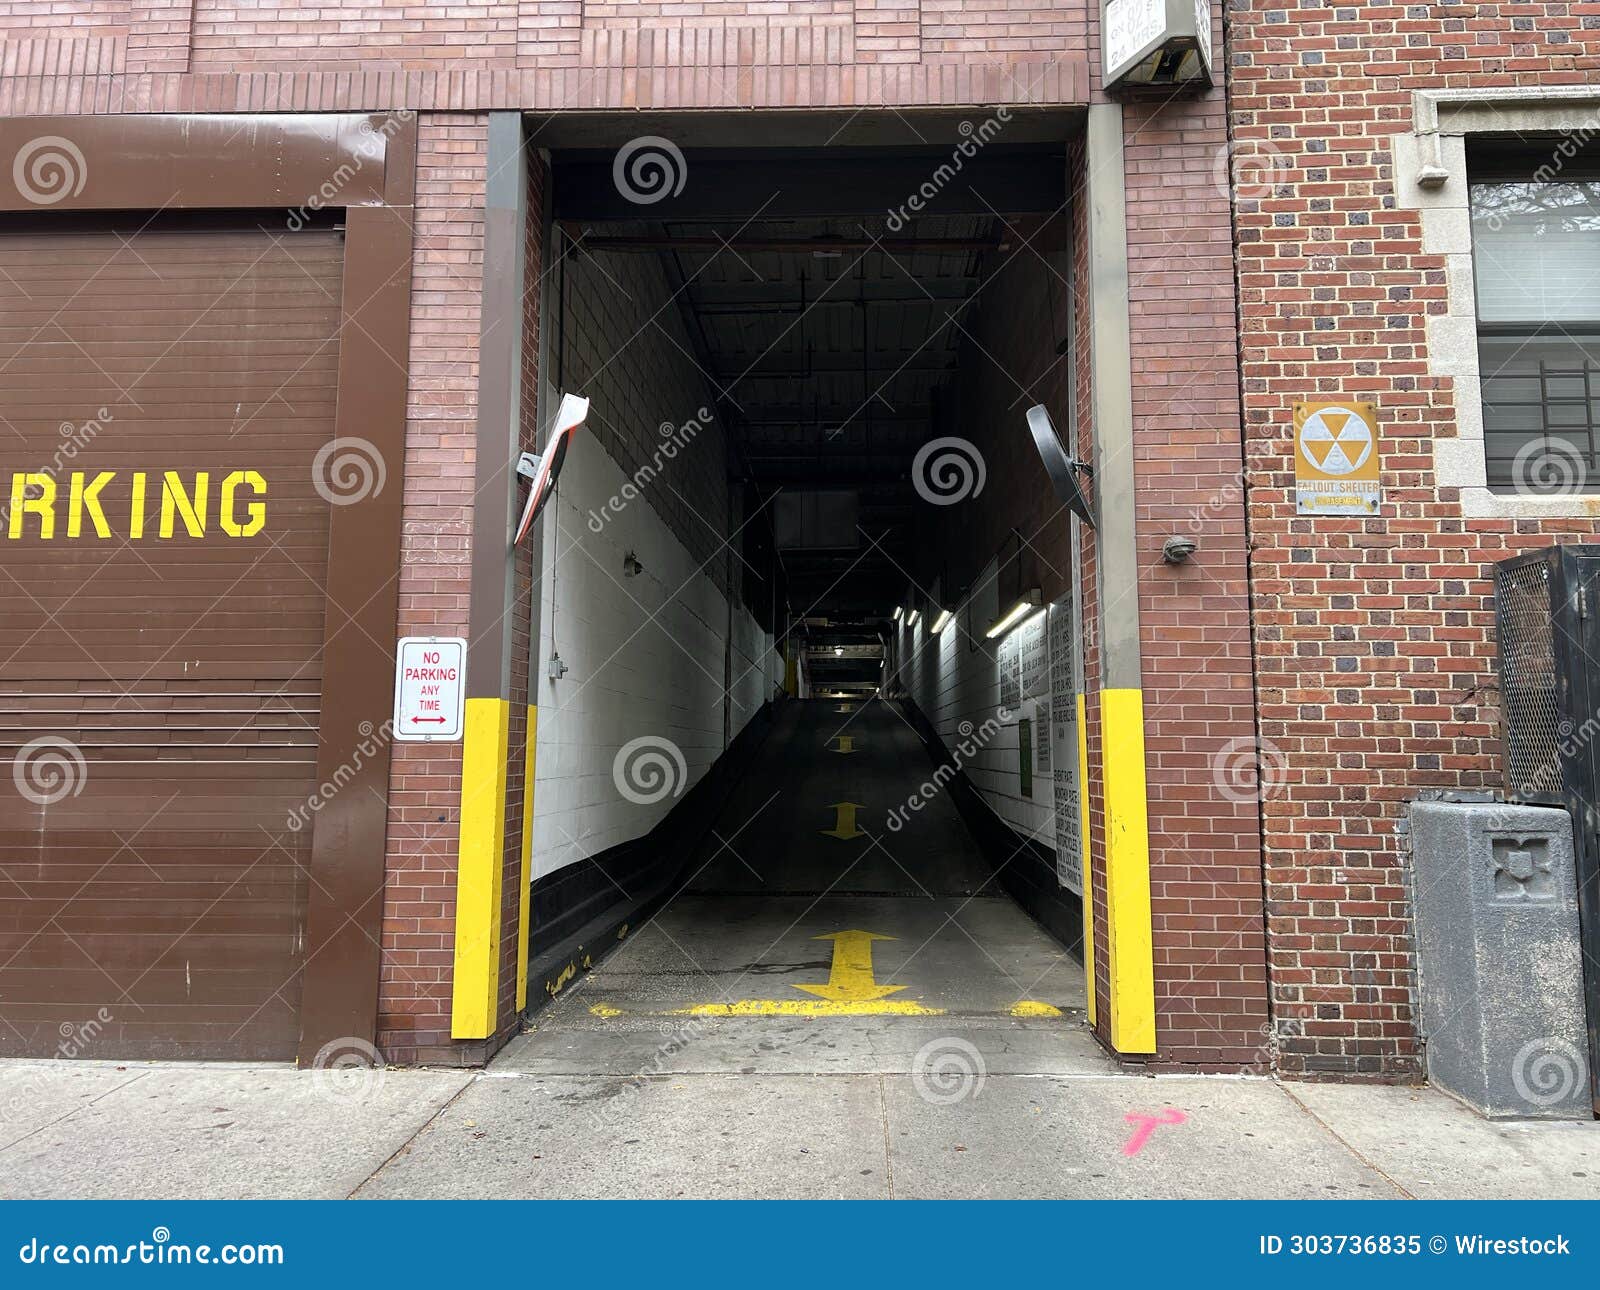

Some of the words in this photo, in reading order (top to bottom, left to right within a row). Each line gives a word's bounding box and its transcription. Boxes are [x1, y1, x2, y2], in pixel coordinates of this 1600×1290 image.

[1297, 482, 1334, 493] FALLOUT
[1340, 482, 1379, 493] SHELTER
[423, 652, 440, 664] NO
[405, 668, 456, 681] PARKING
[420, 685, 440, 696] ANY
[420, 700, 441, 711] TIME
